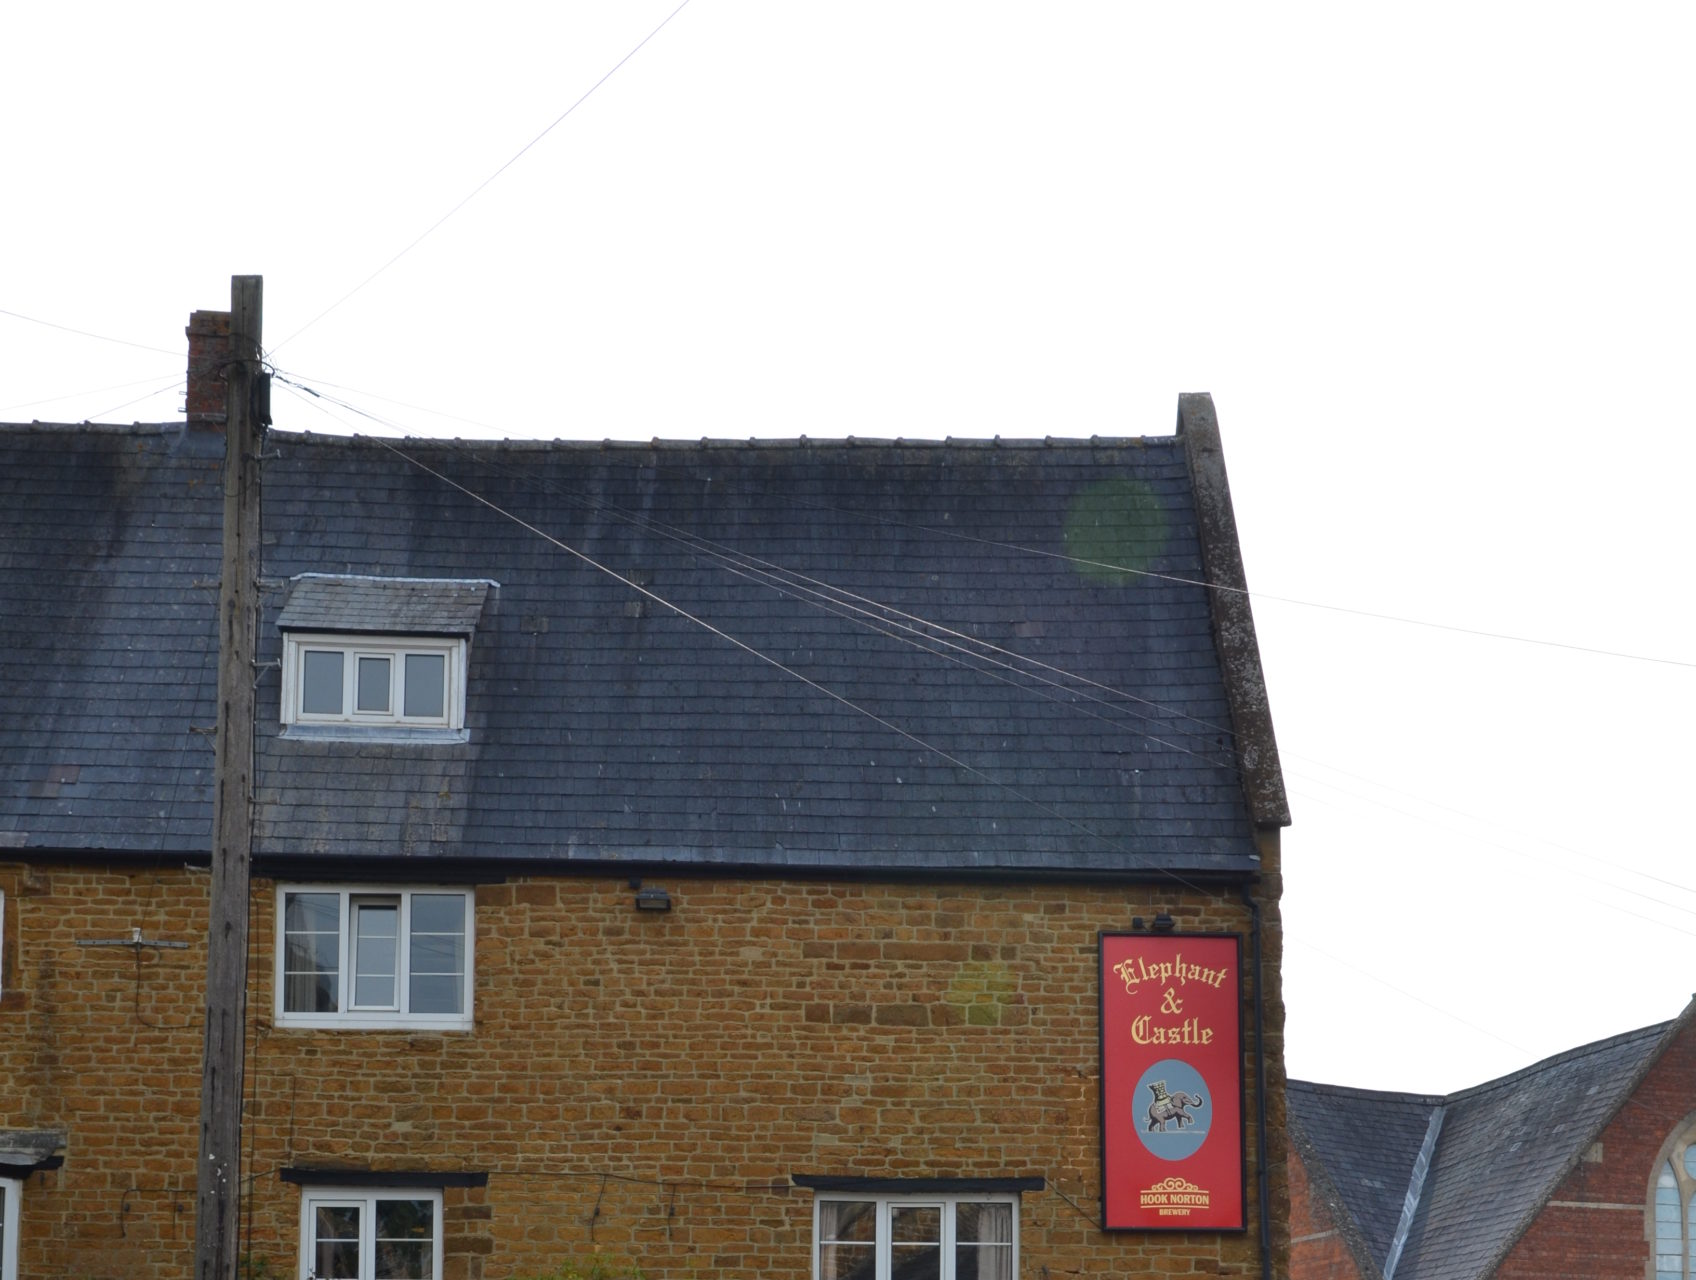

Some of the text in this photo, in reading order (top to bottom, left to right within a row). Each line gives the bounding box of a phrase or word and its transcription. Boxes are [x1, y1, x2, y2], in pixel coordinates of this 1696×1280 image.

[1113, 953, 1227, 994] Elephant
[1160, 987, 1183, 1014] &
[1131, 1015, 1213, 1044] Castle
[1140, 1194, 1209, 1205] HOOK NORTON
[1159, 1208, 1191, 1216] BREWERY
